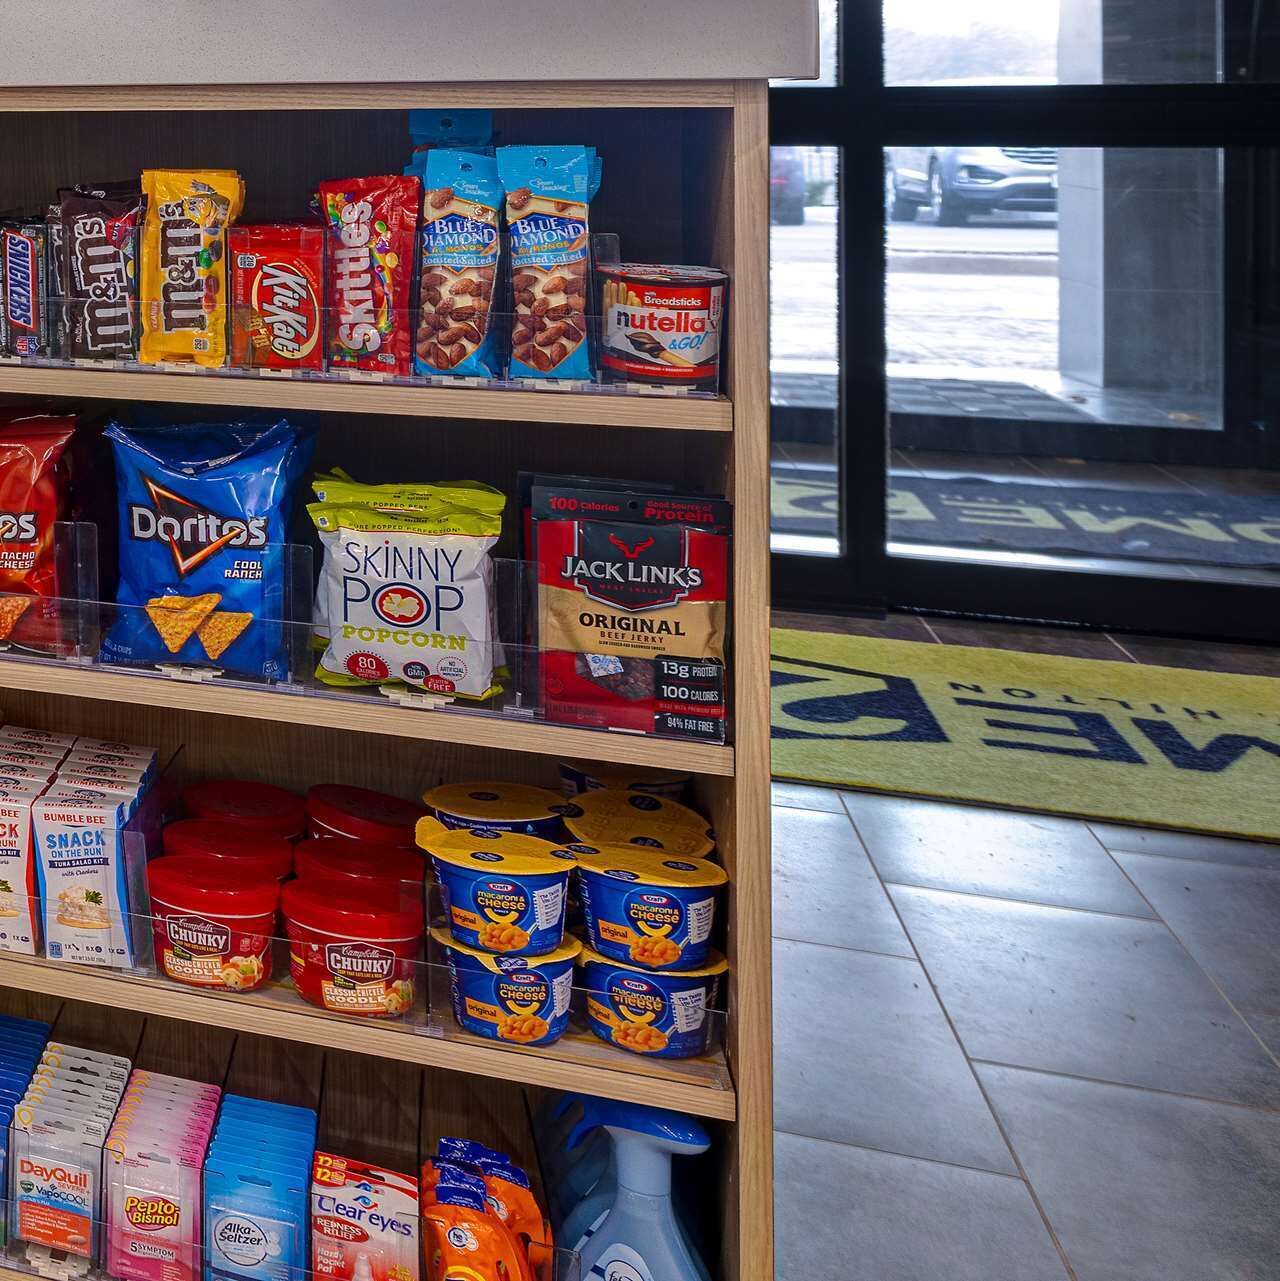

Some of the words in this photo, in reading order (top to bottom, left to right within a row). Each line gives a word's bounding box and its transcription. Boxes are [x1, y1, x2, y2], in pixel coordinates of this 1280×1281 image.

[435, 219, 479, 233] BLUE
[518, 218, 561, 233] BLUE
[8, 234, 33, 328] SNICKERS
[644, 296, 702, 306] Breadsticks
[617, 311, 705, 333] nutella
[550, 496, 577, 511] 100
[581, 502, 620, 512] calories
[645, 508, 715, 523] Protein
[132, 505, 268, 547] Doritos
[0, 552, 35, 561] NACHO
[343, 539, 463, 583] SKINNY
[234, 560, 262, 570] COOL
[224, 568, 263, 579] RANCH
[561, 557, 625, 583] JACK
[628, 562, 702, 588] LINK'S
[579, 612, 686, 636] ORIGINAL
[341, 624, 467, 652] POPCORN
[600, 631, 626, 639] BEEF
[631, 633, 664, 643] JERKY
[358, 656, 376, 669] 80
[407, 669, 426, 677] GMO
[662, 661, 689, 678] 13g
[693, 667, 717, 677] PROTEIN
[428, 683, 451, 692] FREE
[662, 685, 689, 699] 100
[691, 690, 719, 701] CALORIES
[667, 717, 683, 728] 94%
[685, 719, 697, 730] FAT
[698, 721, 714, 732] FREE
[1, 808, 20, 818] BEE
[44, 813, 85, 823] BUMBLE
[86, 815, 105, 824] BEE
[46, 831, 106, 849] SNACK
[52, 849, 63, 858] ON
[65, 848, 82, 858] THE
[54, 860, 71, 868] TUNA
[72, 859, 92, 867] SALAD
[477, 890, 518, 902] macaroni
[646, 895, 666, 903] Kraft
[630, 903, 671, 914] macaroni
[454, 913, 476, 923] original
[169, 923, 227, 949] CHUNKY
[601, 927, 628, 938] original
[330, 954, 392, 974] CHUNKY
[514, 974, 532, 982] Kraft
[324, 987, 356, 998] CLASSIC
[500, 983, 539, 993] macaroni
[468, 1005, 497, 1017] original
[318, 1156, 332, 1166] 12
[19, 1159, 88, 1188] DayQuil
[316, 1168, 330, 1181] 12
[57, 1182, 85, 1191] SEVERE
[35, 1185, 89, 1207] VapoCOOL
[125, 1196, 181, 1216] Pepto-
[132, 1211, 179, 1227] Bismol
[318, 1197, 366, 1220] Clear
[369, 1213, 412, 1236] eyes
[222, 1222, 256, 1235] Alka-
[317, 1218, 362, 1236] REDNESS
[218, 1231, 263, 1247] Seltzer
[138, 1243, 174, 1257] SYMPTOM
